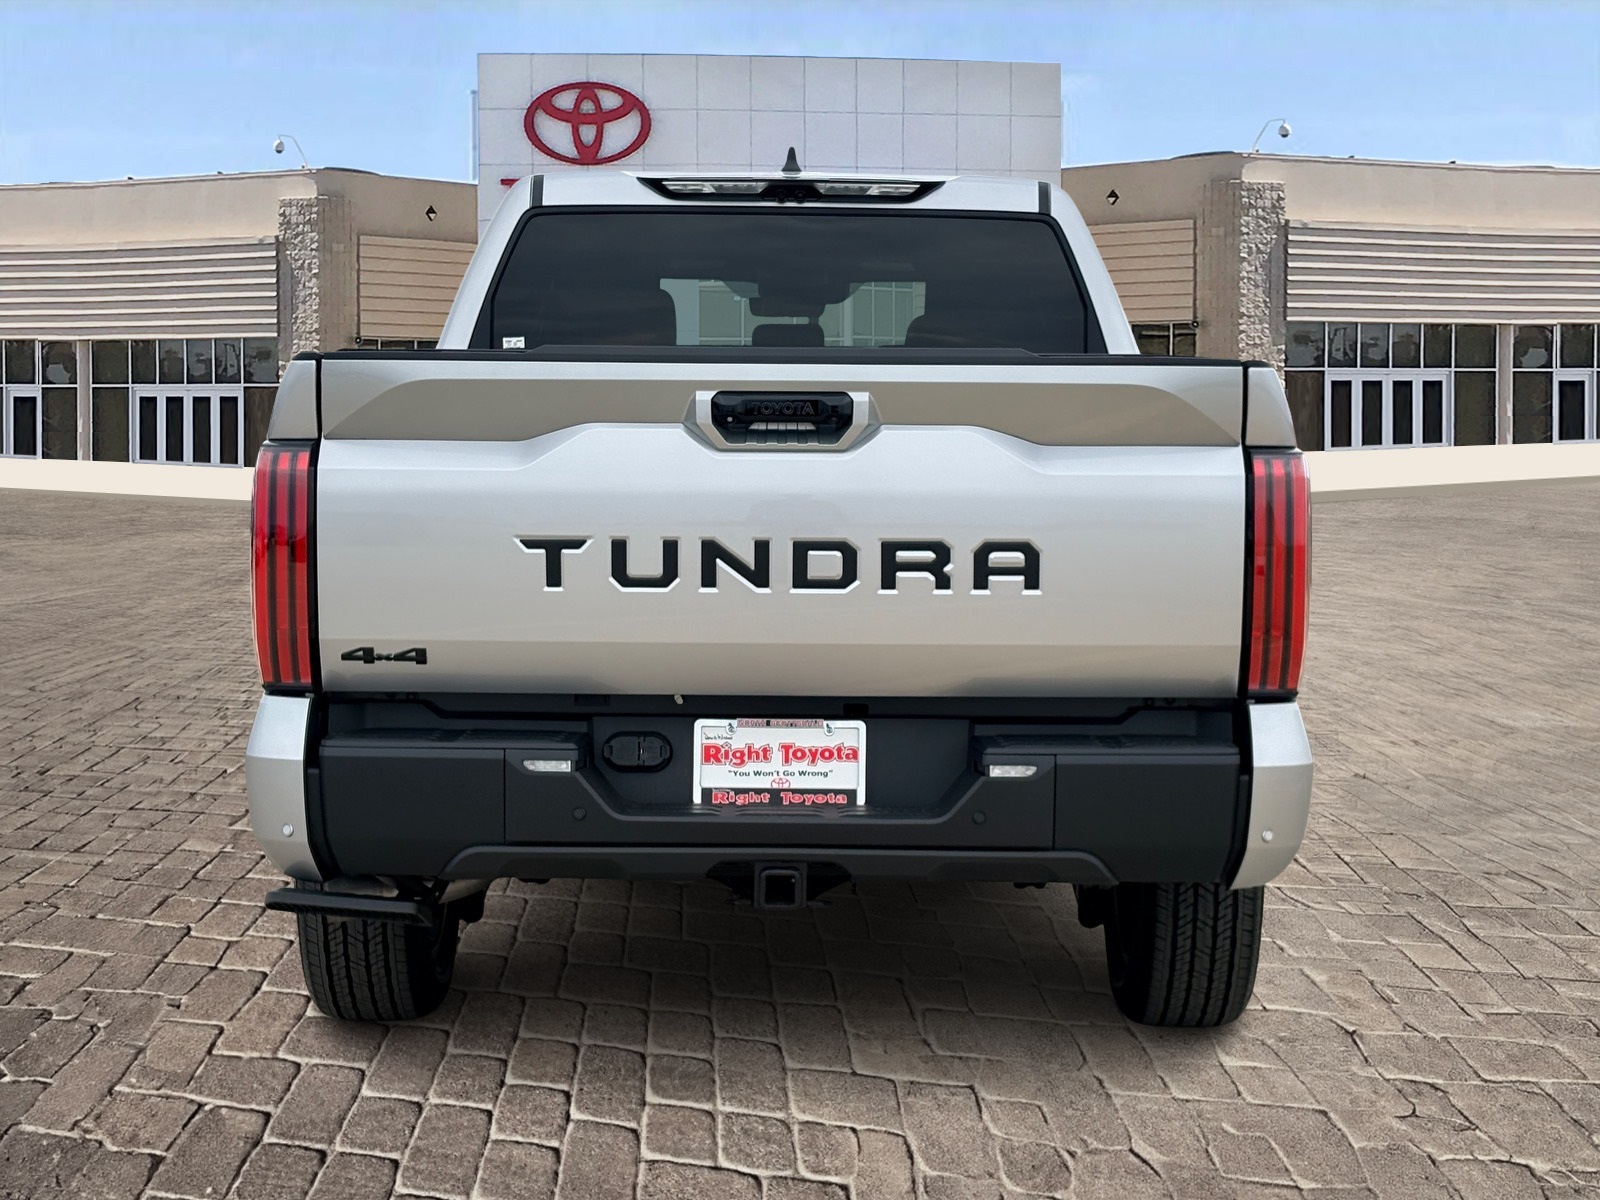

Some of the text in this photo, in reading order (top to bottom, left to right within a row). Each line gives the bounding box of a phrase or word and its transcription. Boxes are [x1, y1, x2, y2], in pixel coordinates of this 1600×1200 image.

[752, 402, 815, 415] TOYOTA
[513, 537, 1043, 594] TUNDRA
[702, 742, 860, 768] Right Toyota
[753, 770, 780, 778] Won't
[783, 770, 796, 778] Go
[712, 791, 848, 806] Right Toyota
